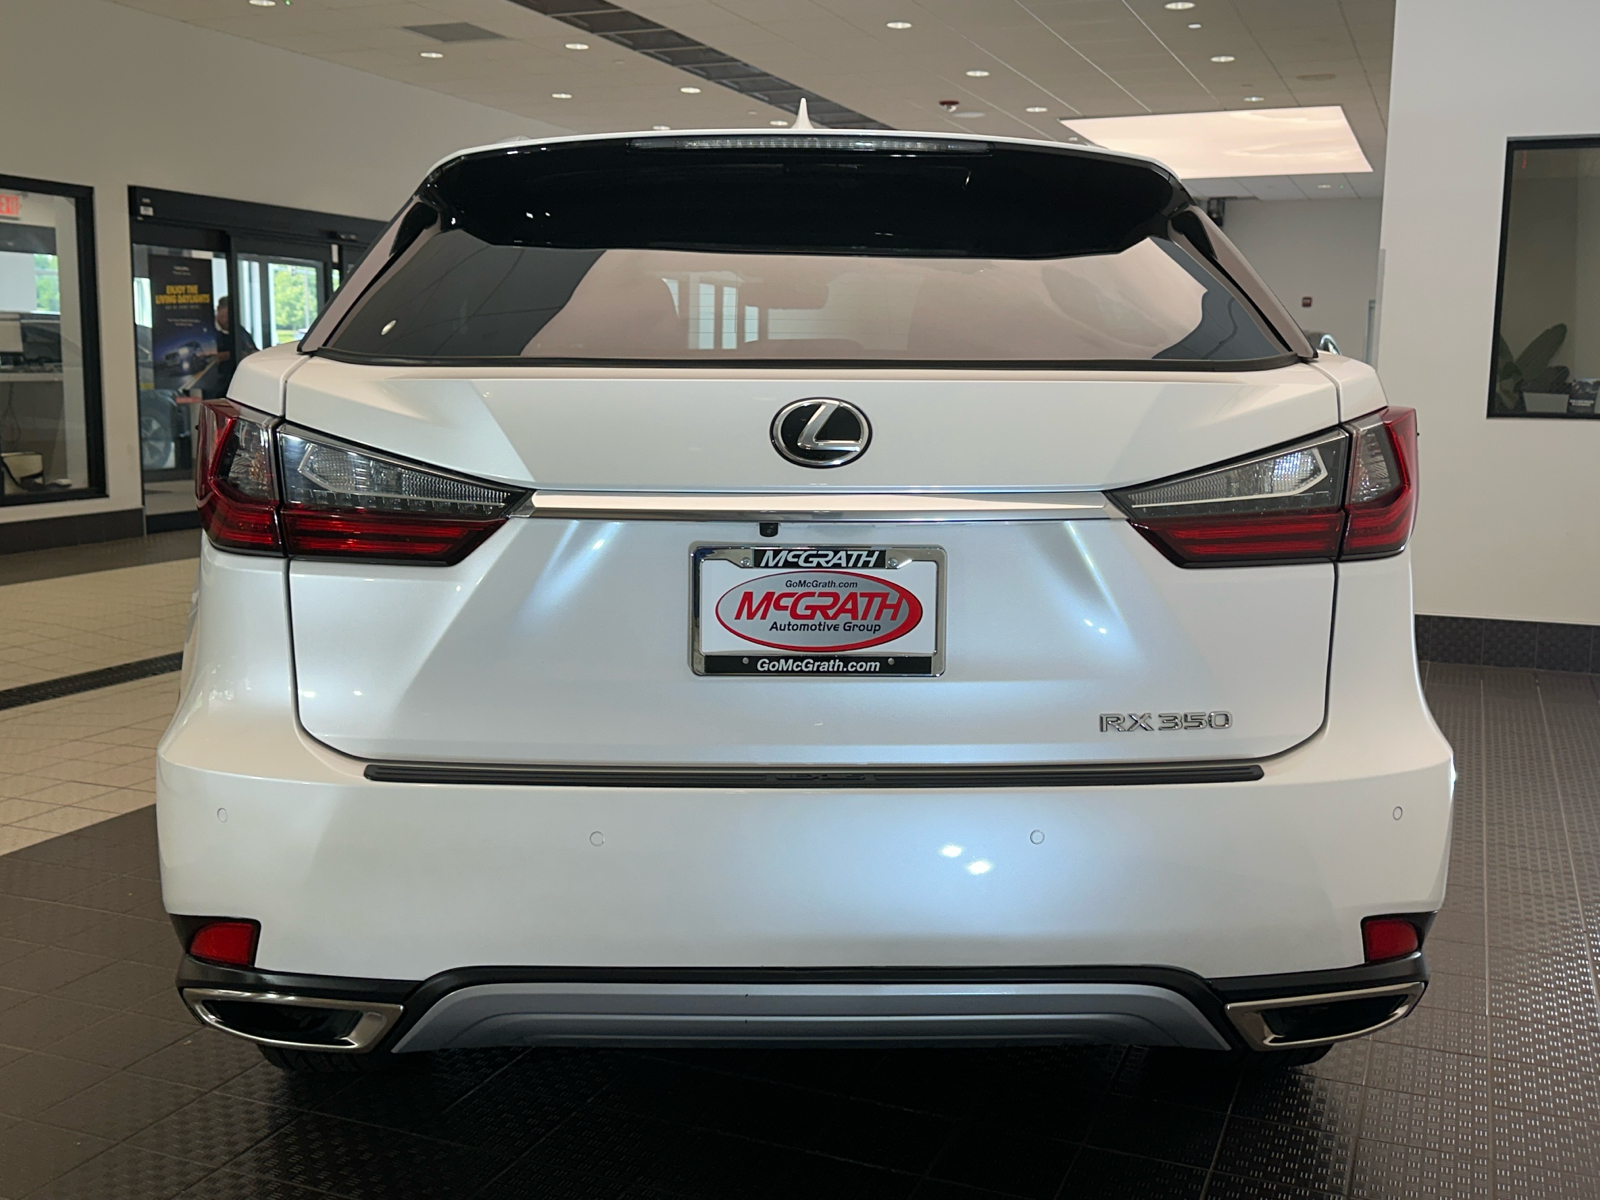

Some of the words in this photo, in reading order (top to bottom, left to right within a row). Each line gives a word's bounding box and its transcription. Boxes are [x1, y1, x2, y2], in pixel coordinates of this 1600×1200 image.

[785, 579, 858, 589] GoMcGrath.com
[769, 621, 840, 632] Automotive
[843, 621, 881, 634] Group
[757, 659, 880, 672] GoMcGrath.com
[1099, 712, 1154, 732] RX
[1158, 711, 1233, 730] 350
